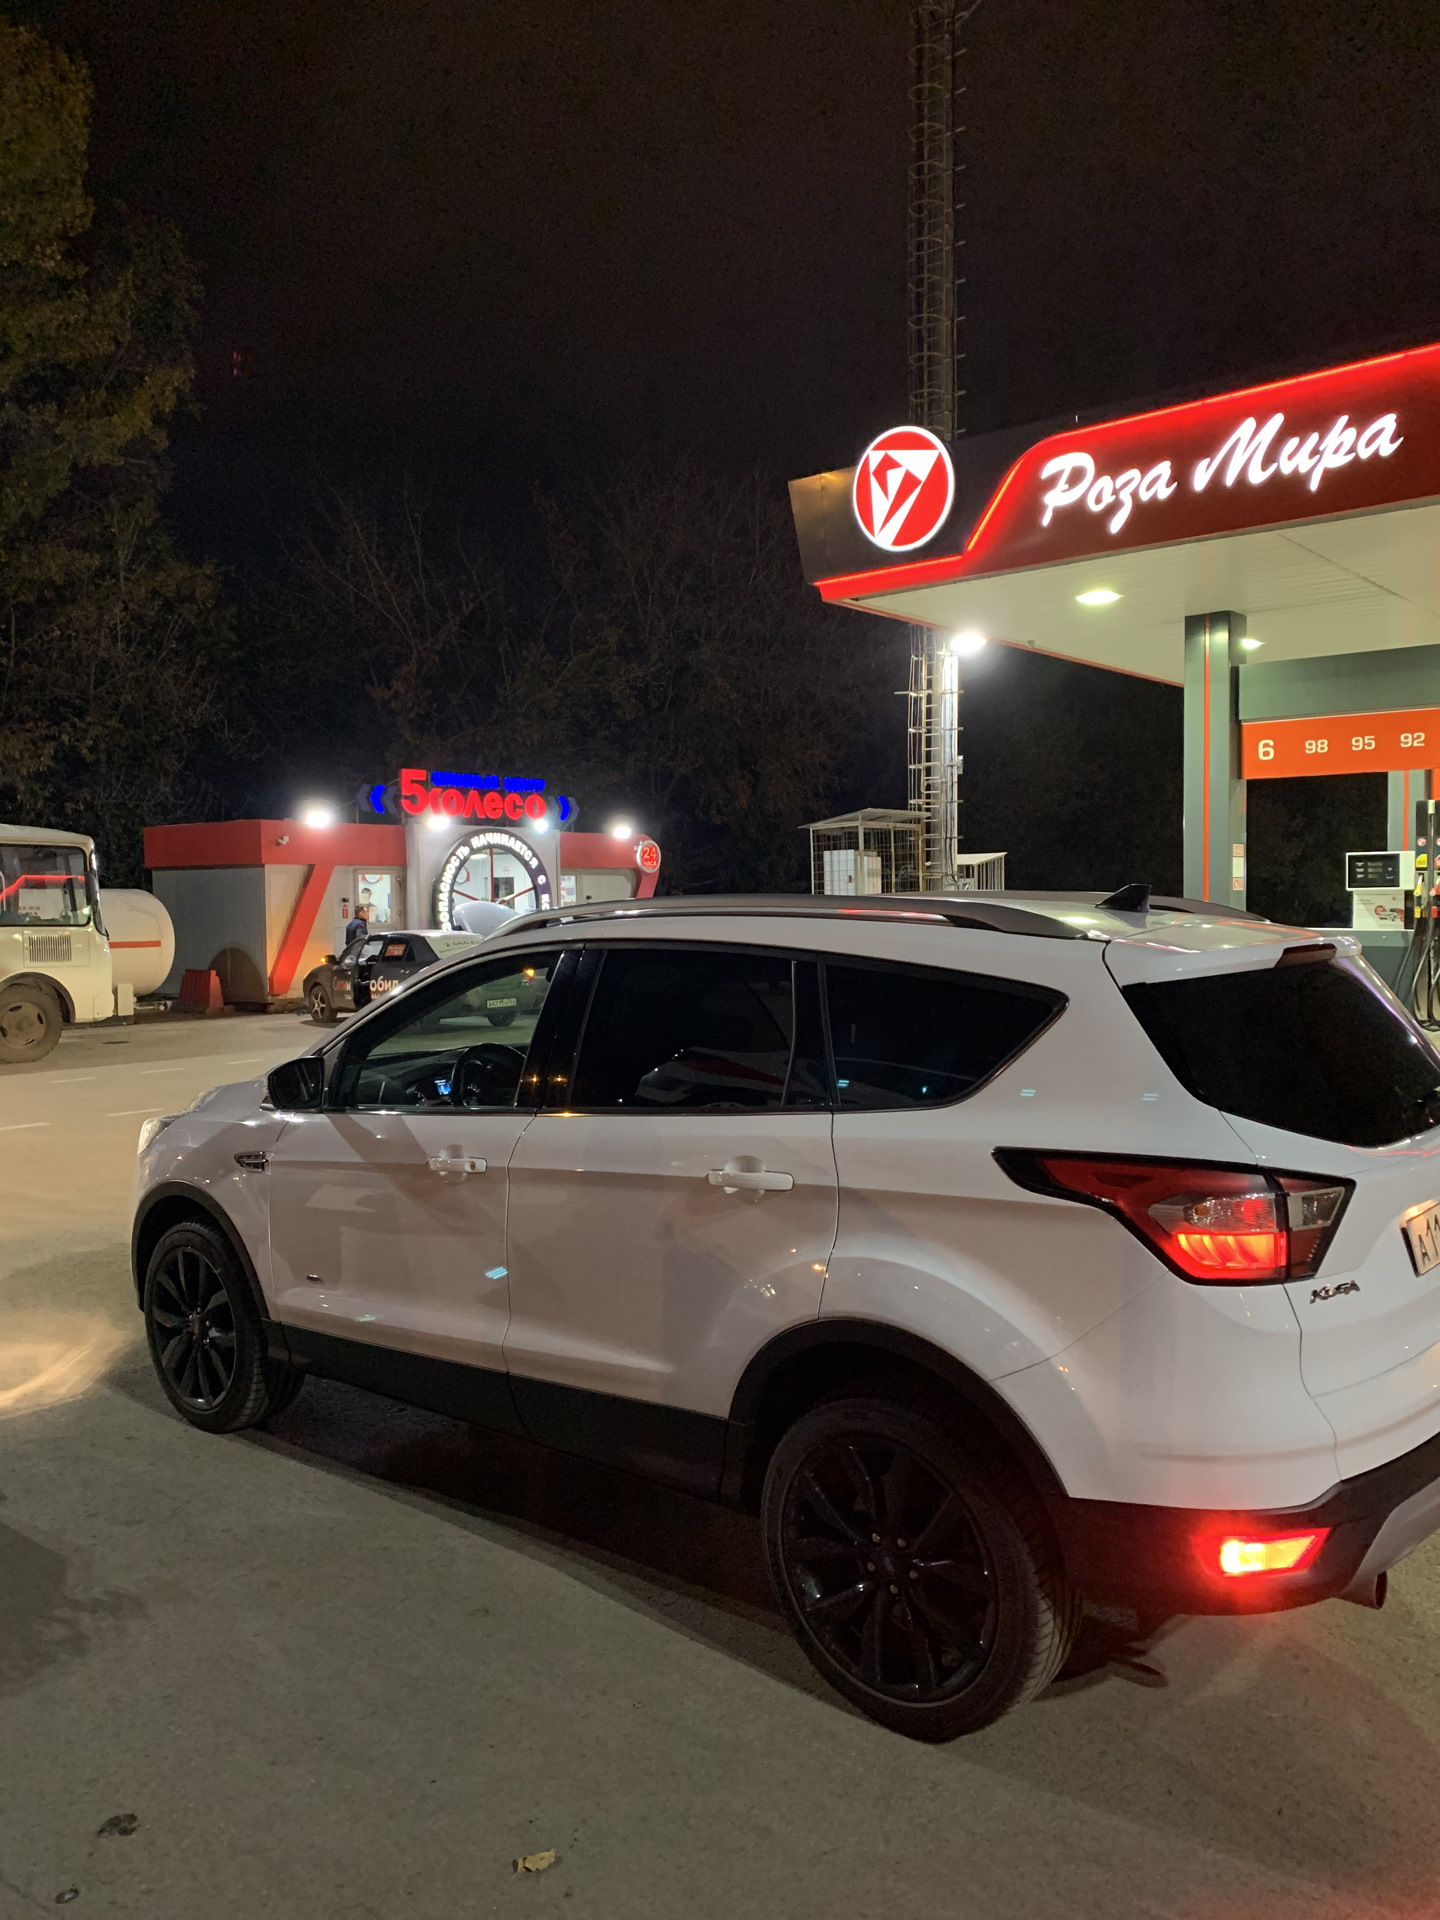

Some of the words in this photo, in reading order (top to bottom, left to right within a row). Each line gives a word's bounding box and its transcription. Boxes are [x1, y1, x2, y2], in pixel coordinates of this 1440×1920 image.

[1040, 452, 1177, 535] Роза
[1193, 411, 1405, 492] Мира
[1258, 739, 1275, 761] 6
[1304, 739, 1329, 754] 98
[1351, 735, 1376, 751] 95
[1400, 732, 1425, 748] 92
[470, 832, 539, 869] НАЧИНАЕТСЯ
[643, 846, 657, 859] 24
